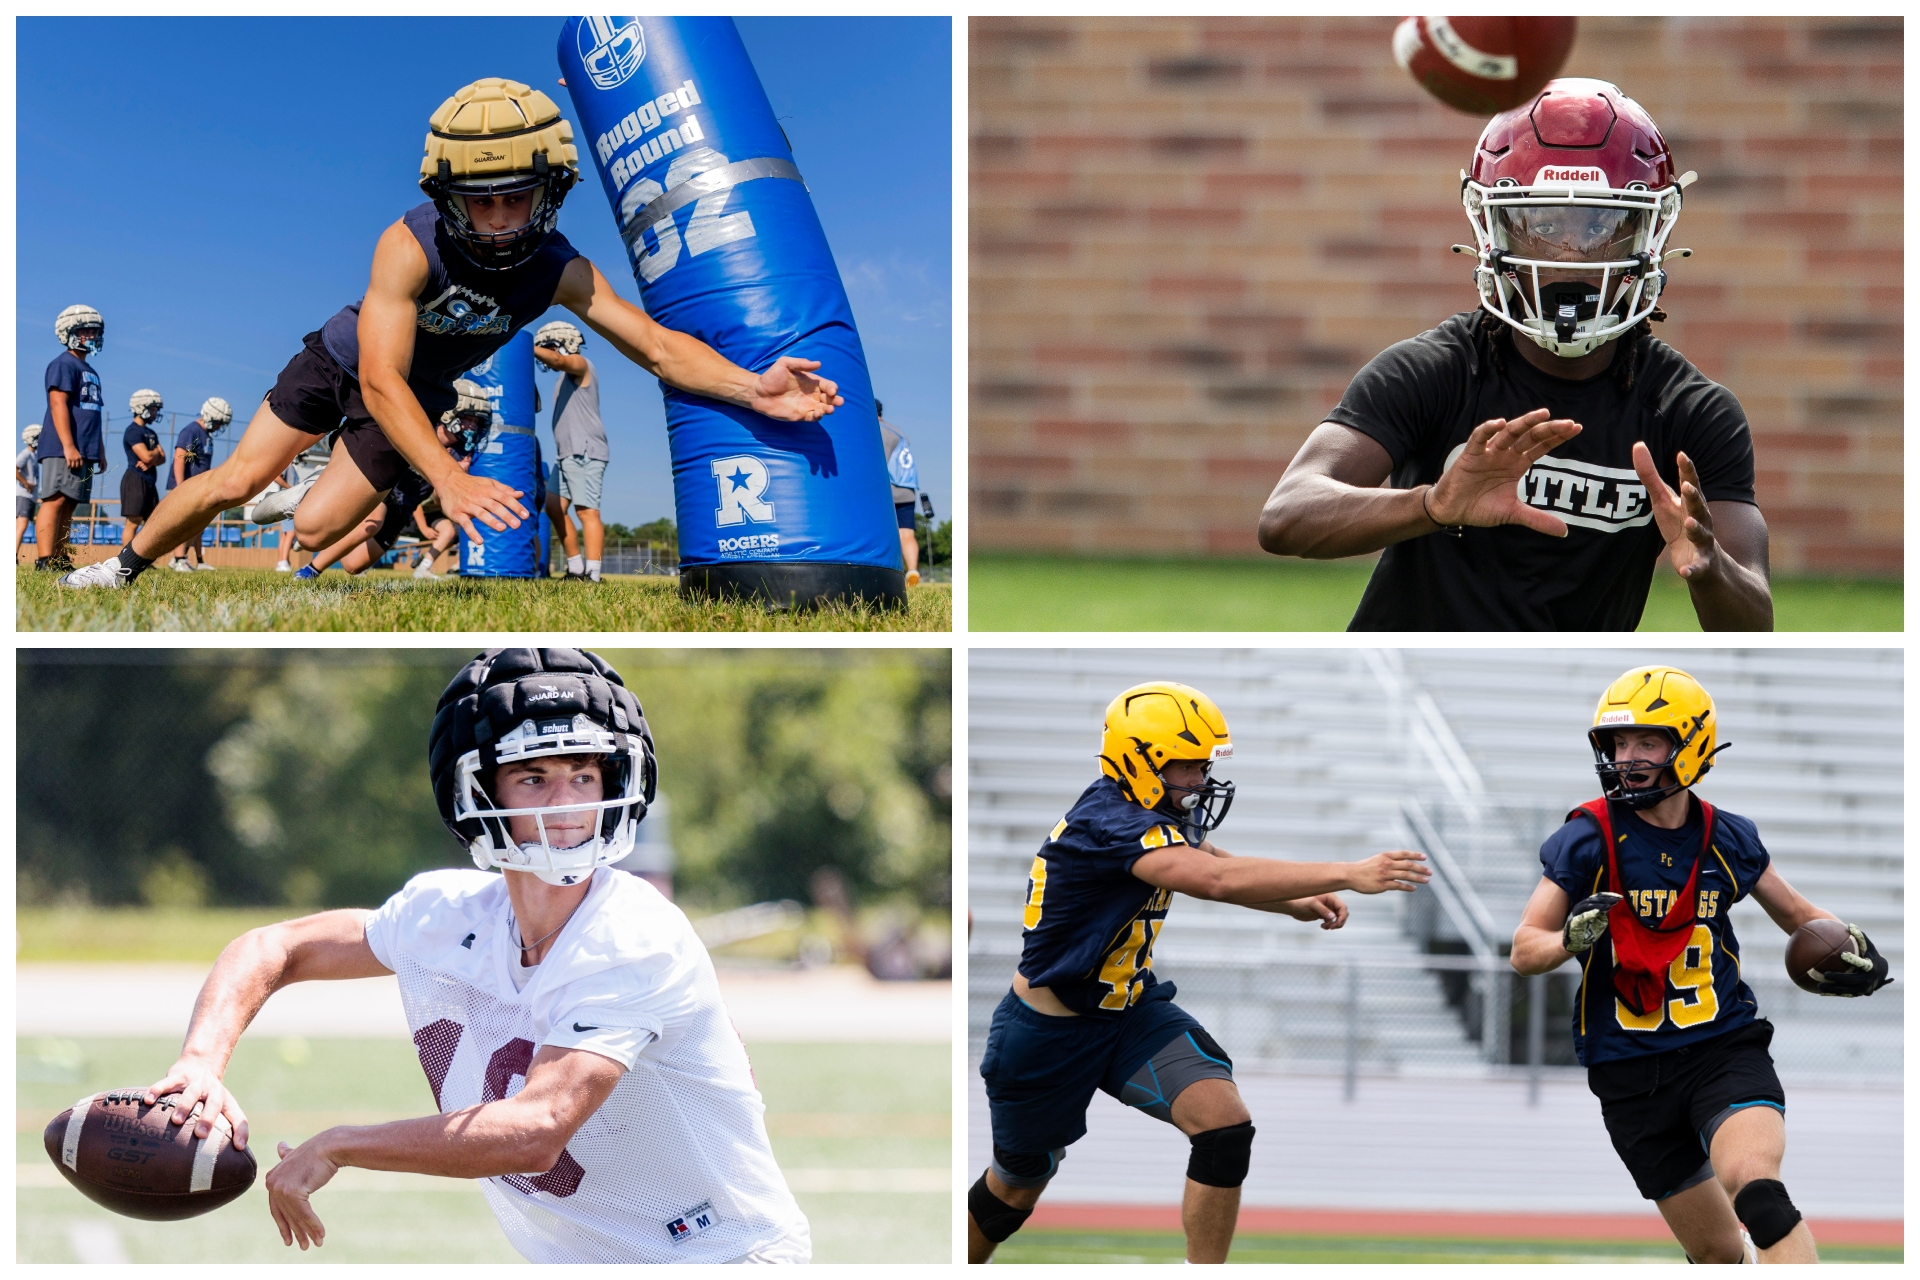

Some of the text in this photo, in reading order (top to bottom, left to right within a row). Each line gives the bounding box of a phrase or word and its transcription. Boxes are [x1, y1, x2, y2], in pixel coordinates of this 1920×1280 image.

[595, 79, 702, 167] Rugged
[473, 155, 505, 164] GUARDIAN
[610, 114, 705, 192] Round
[1543, 169, 1600, 182] Riddell
[711, 454, 776, 528] R
[717, 534, 780, 552] ROGERS
[1601, 714, 1630, 724] Riddell
[542, 723, 569, 734] schutt
[103, 1113, 175, 1143] Wilson
[107, 1147, 157, 1165] GST
[695, 1213, 711, 1229] M
